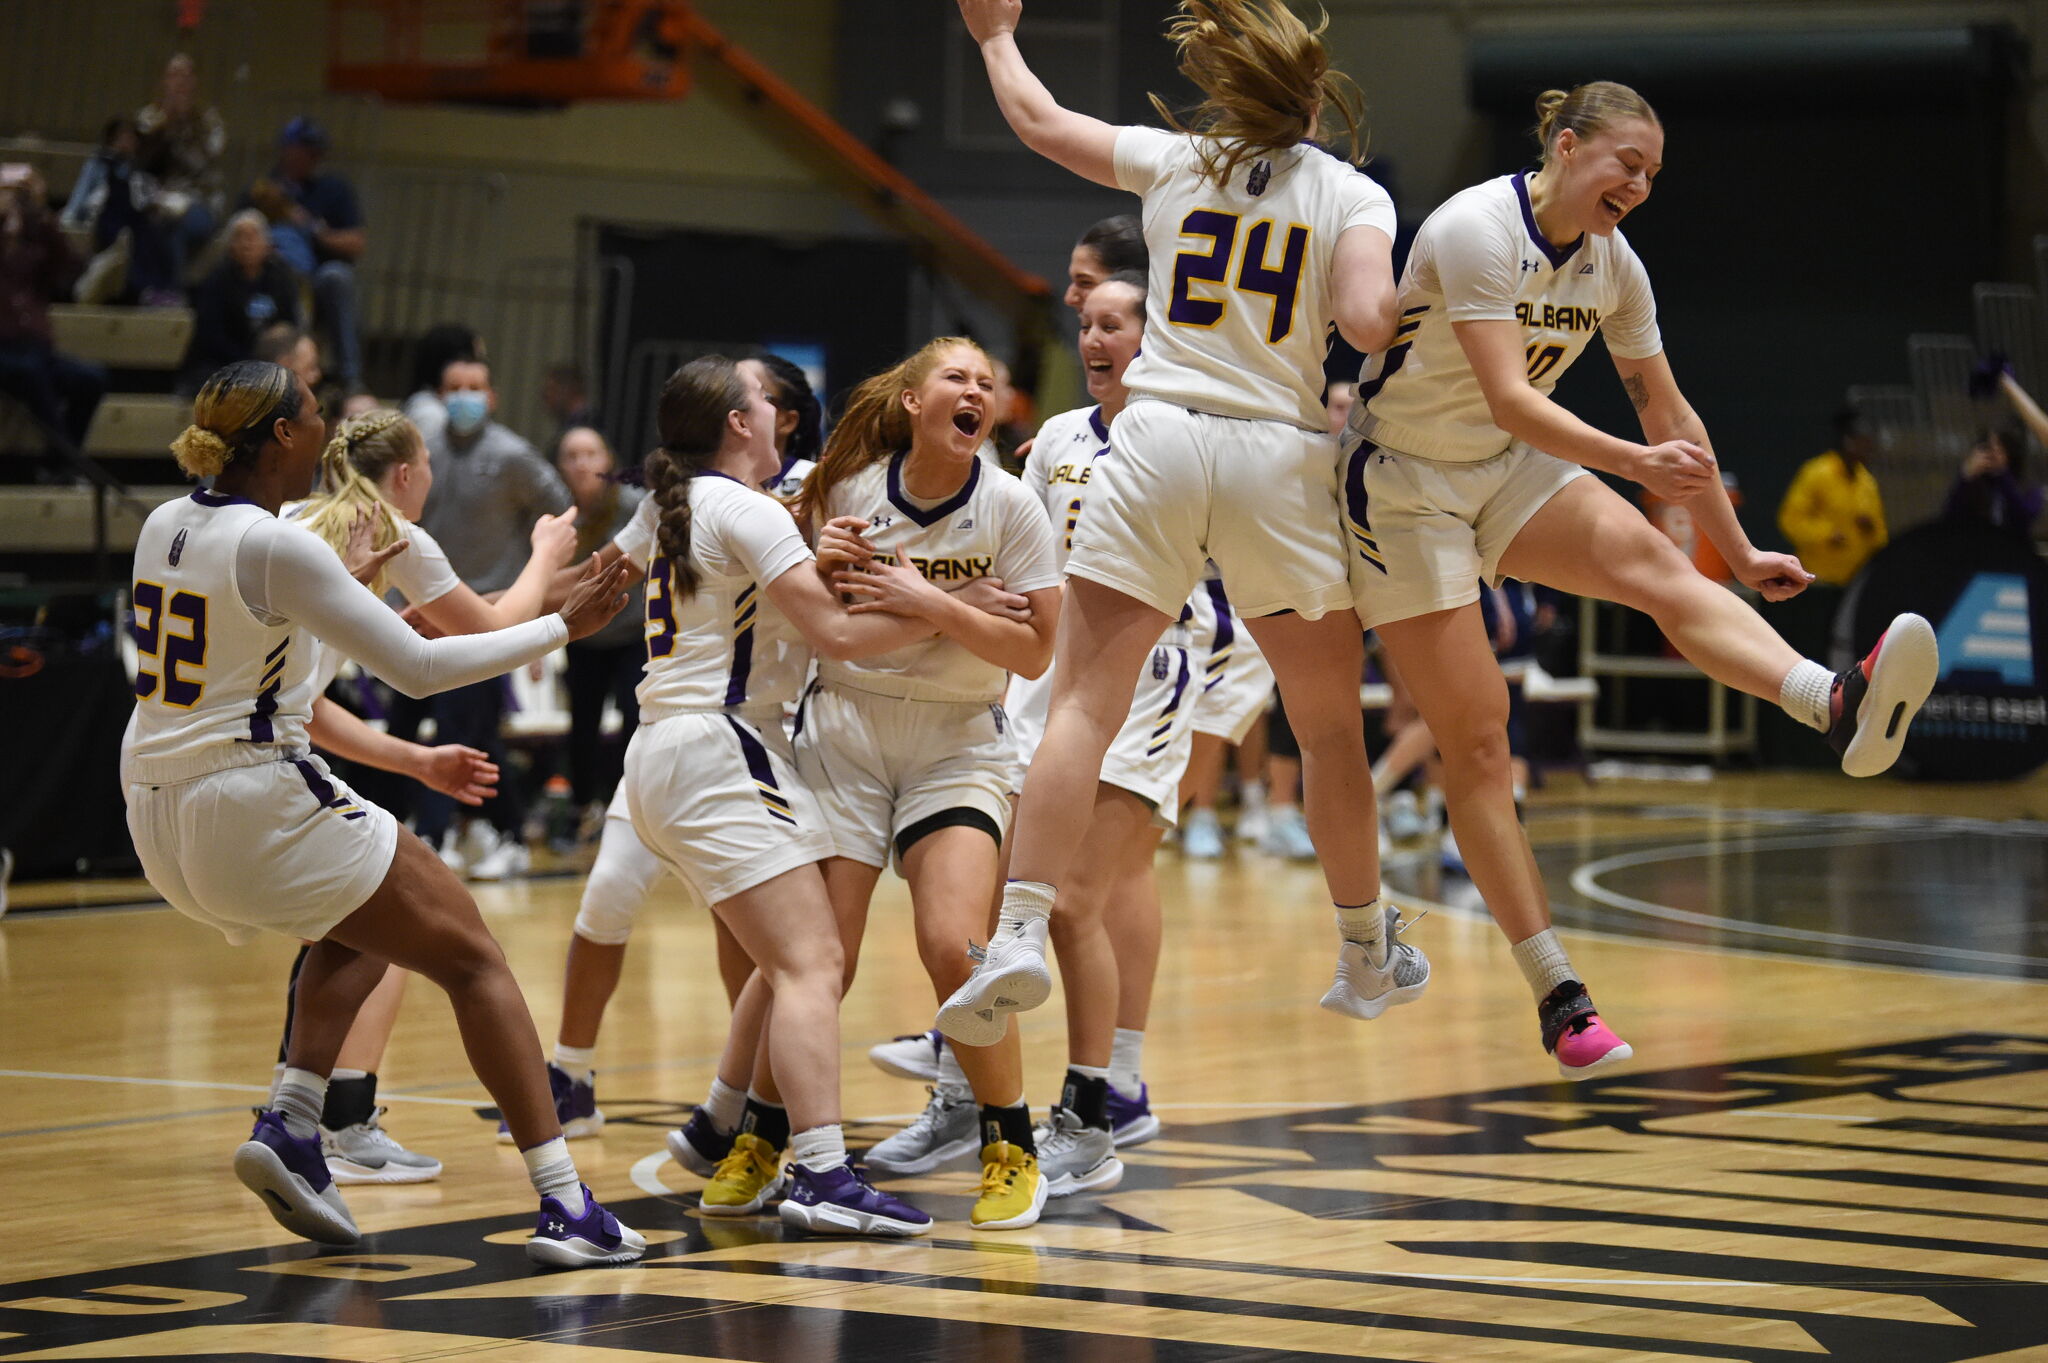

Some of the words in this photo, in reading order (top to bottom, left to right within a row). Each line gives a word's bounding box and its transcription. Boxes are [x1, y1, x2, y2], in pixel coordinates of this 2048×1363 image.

[1168, 207, 1312, 345] 24
[1515, 302, 1600, 332] ALBANY
[134, 579, 209, 710] 22
[643, 553, 680, 661] 3
